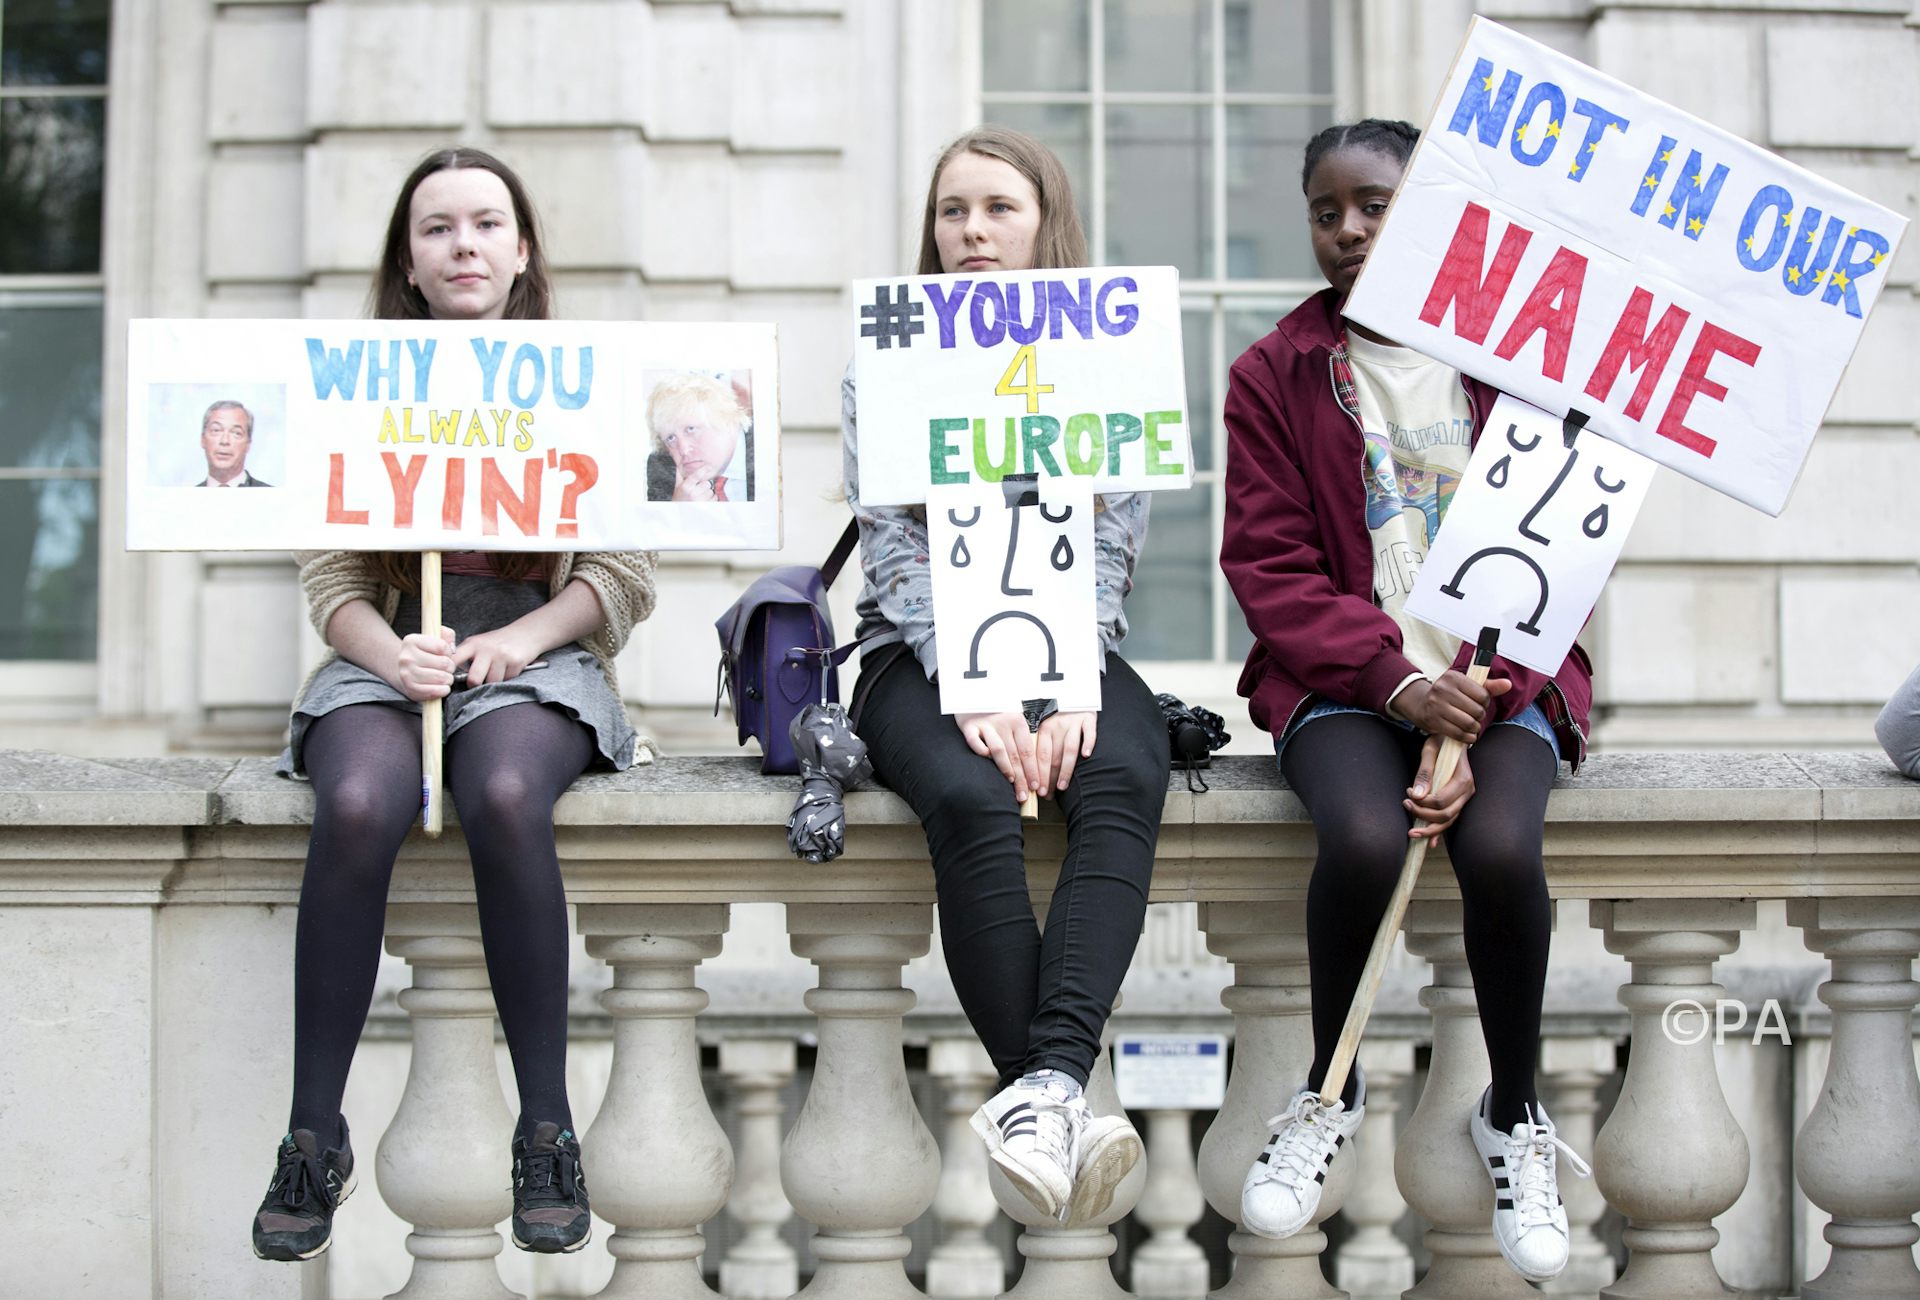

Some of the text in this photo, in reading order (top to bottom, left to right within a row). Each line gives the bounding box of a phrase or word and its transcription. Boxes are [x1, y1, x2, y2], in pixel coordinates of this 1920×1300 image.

[1446, 56, 1891, 320] NOT IN OUR
[860, 276, 1140, 350] #YOUNG
[1418, 200, 1763, 460] NAME
[303, 336, 594, 410] WHY YOU
[994, 344, 1055, 414] 4
[377, 406, 535, 452] ALWAYS
[928, 410, 1185, 486] EUROPE
[325, 447, 600, 539] LYIN'?
